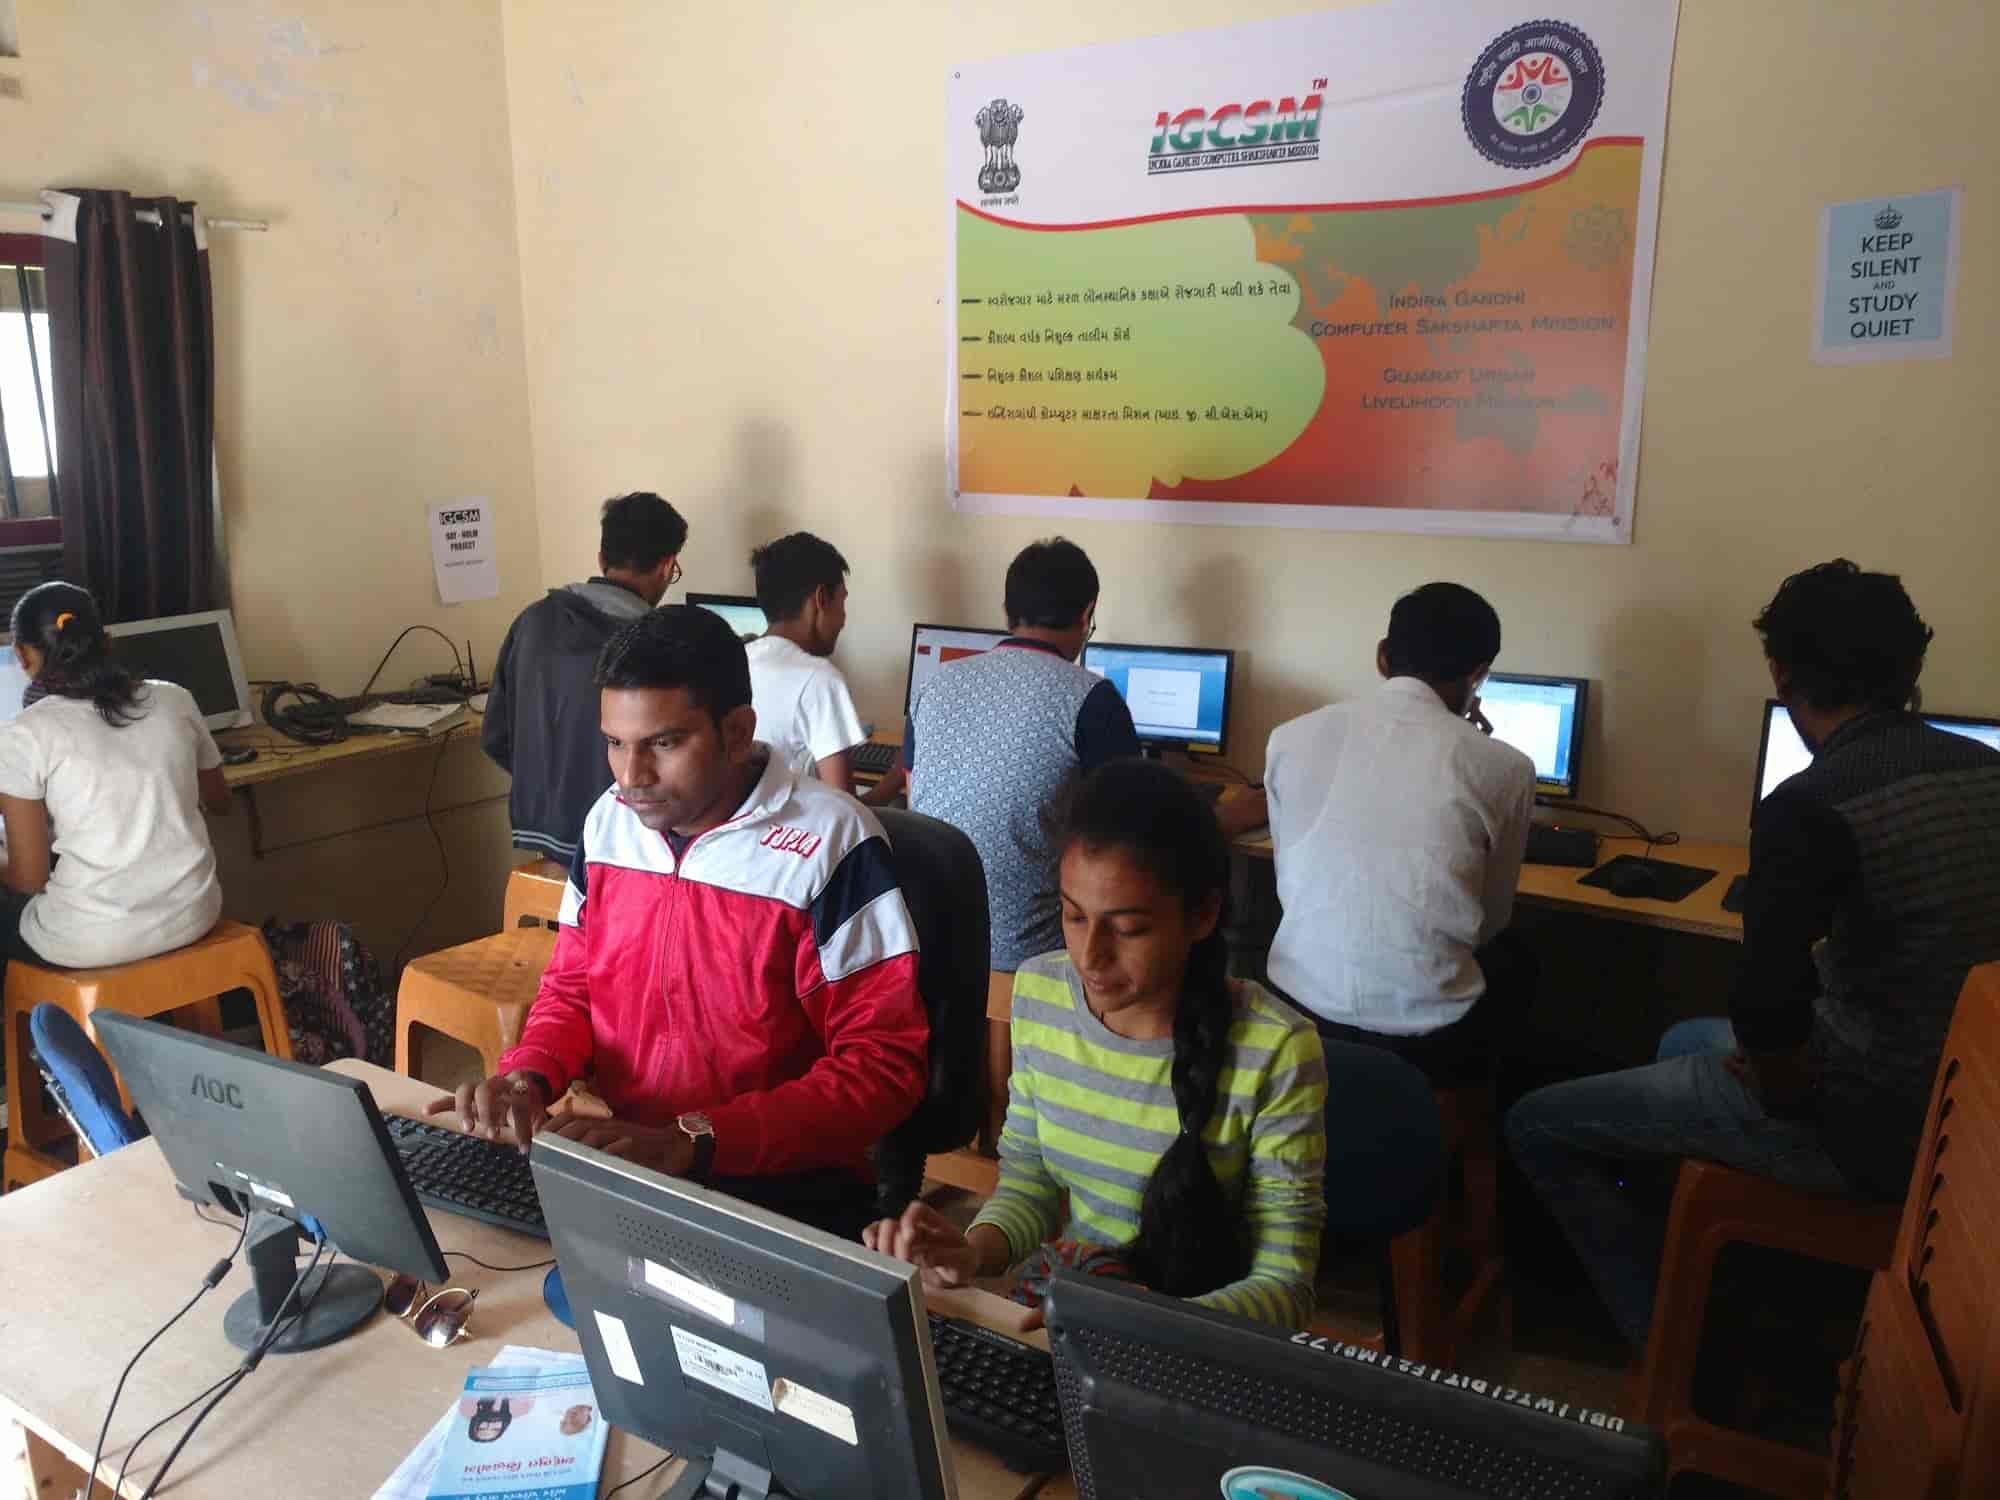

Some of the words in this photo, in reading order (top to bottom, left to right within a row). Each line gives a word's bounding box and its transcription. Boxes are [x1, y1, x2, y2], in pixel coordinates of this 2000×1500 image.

[1312, 77, 1328, 89] TM
[1150, 94, 1323, 153] IGCSM
[1861, 233, 1913, 254] KEEP
[1850, 256, 1921, 279] SILENT
[1873, 280, 1895, 290] AND
[1848, 292, 1919, 314] STUDY
[1310, 319, 1408, 337] COMPUTER
[1850, 318, 1915, 338] QUIET
[191, 1074, 244, 1109] AOC
